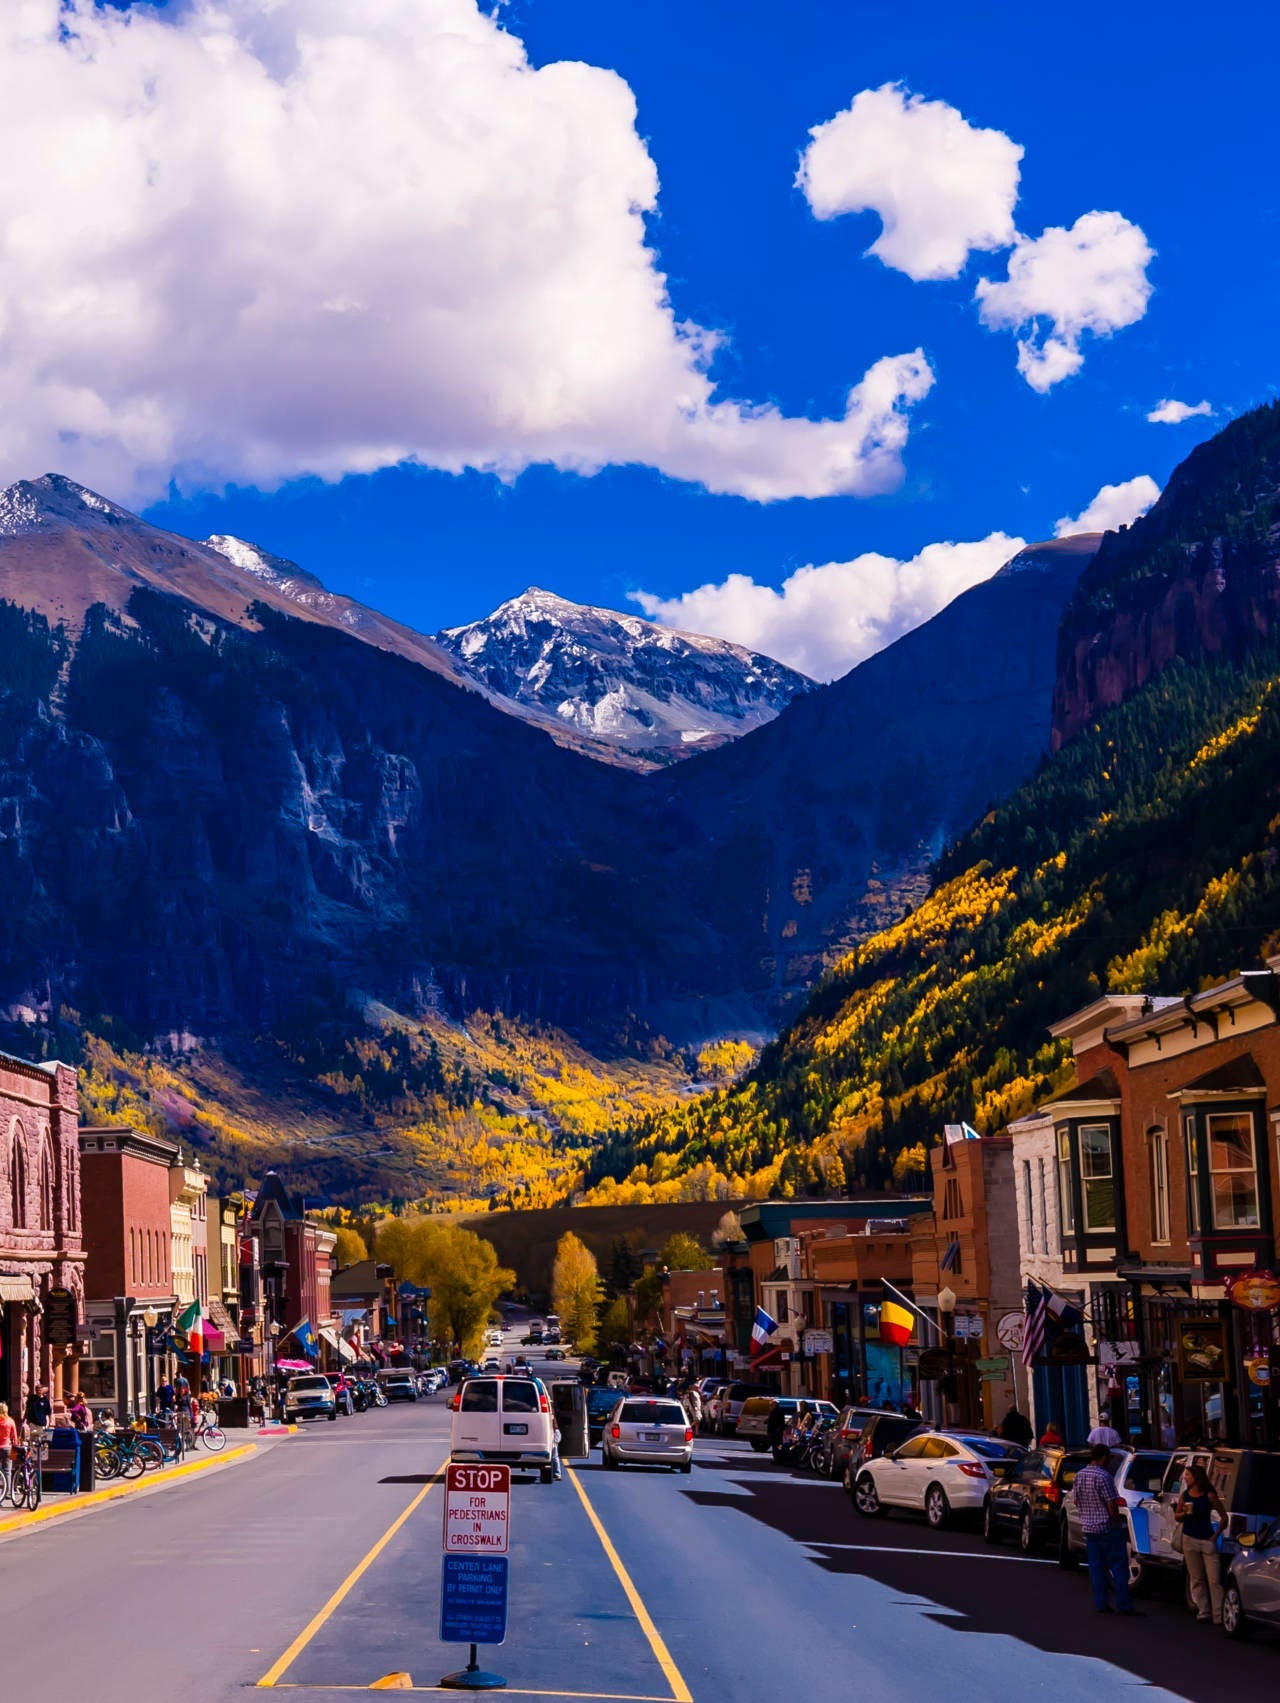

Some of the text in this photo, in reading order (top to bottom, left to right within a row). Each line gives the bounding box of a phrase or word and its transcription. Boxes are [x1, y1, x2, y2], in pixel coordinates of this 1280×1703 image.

[455, 1469, 502, 1489] STOP
[469, 1497, 486, 1508] FOR
[448, 1508, 506, 1521] PEDESTRIANS
[472, 1522, 482, 1533] IN
[451, 1534, 502, 1546] CROSSWALK
[447, 1561, 504, 1573] CENTER LANE
